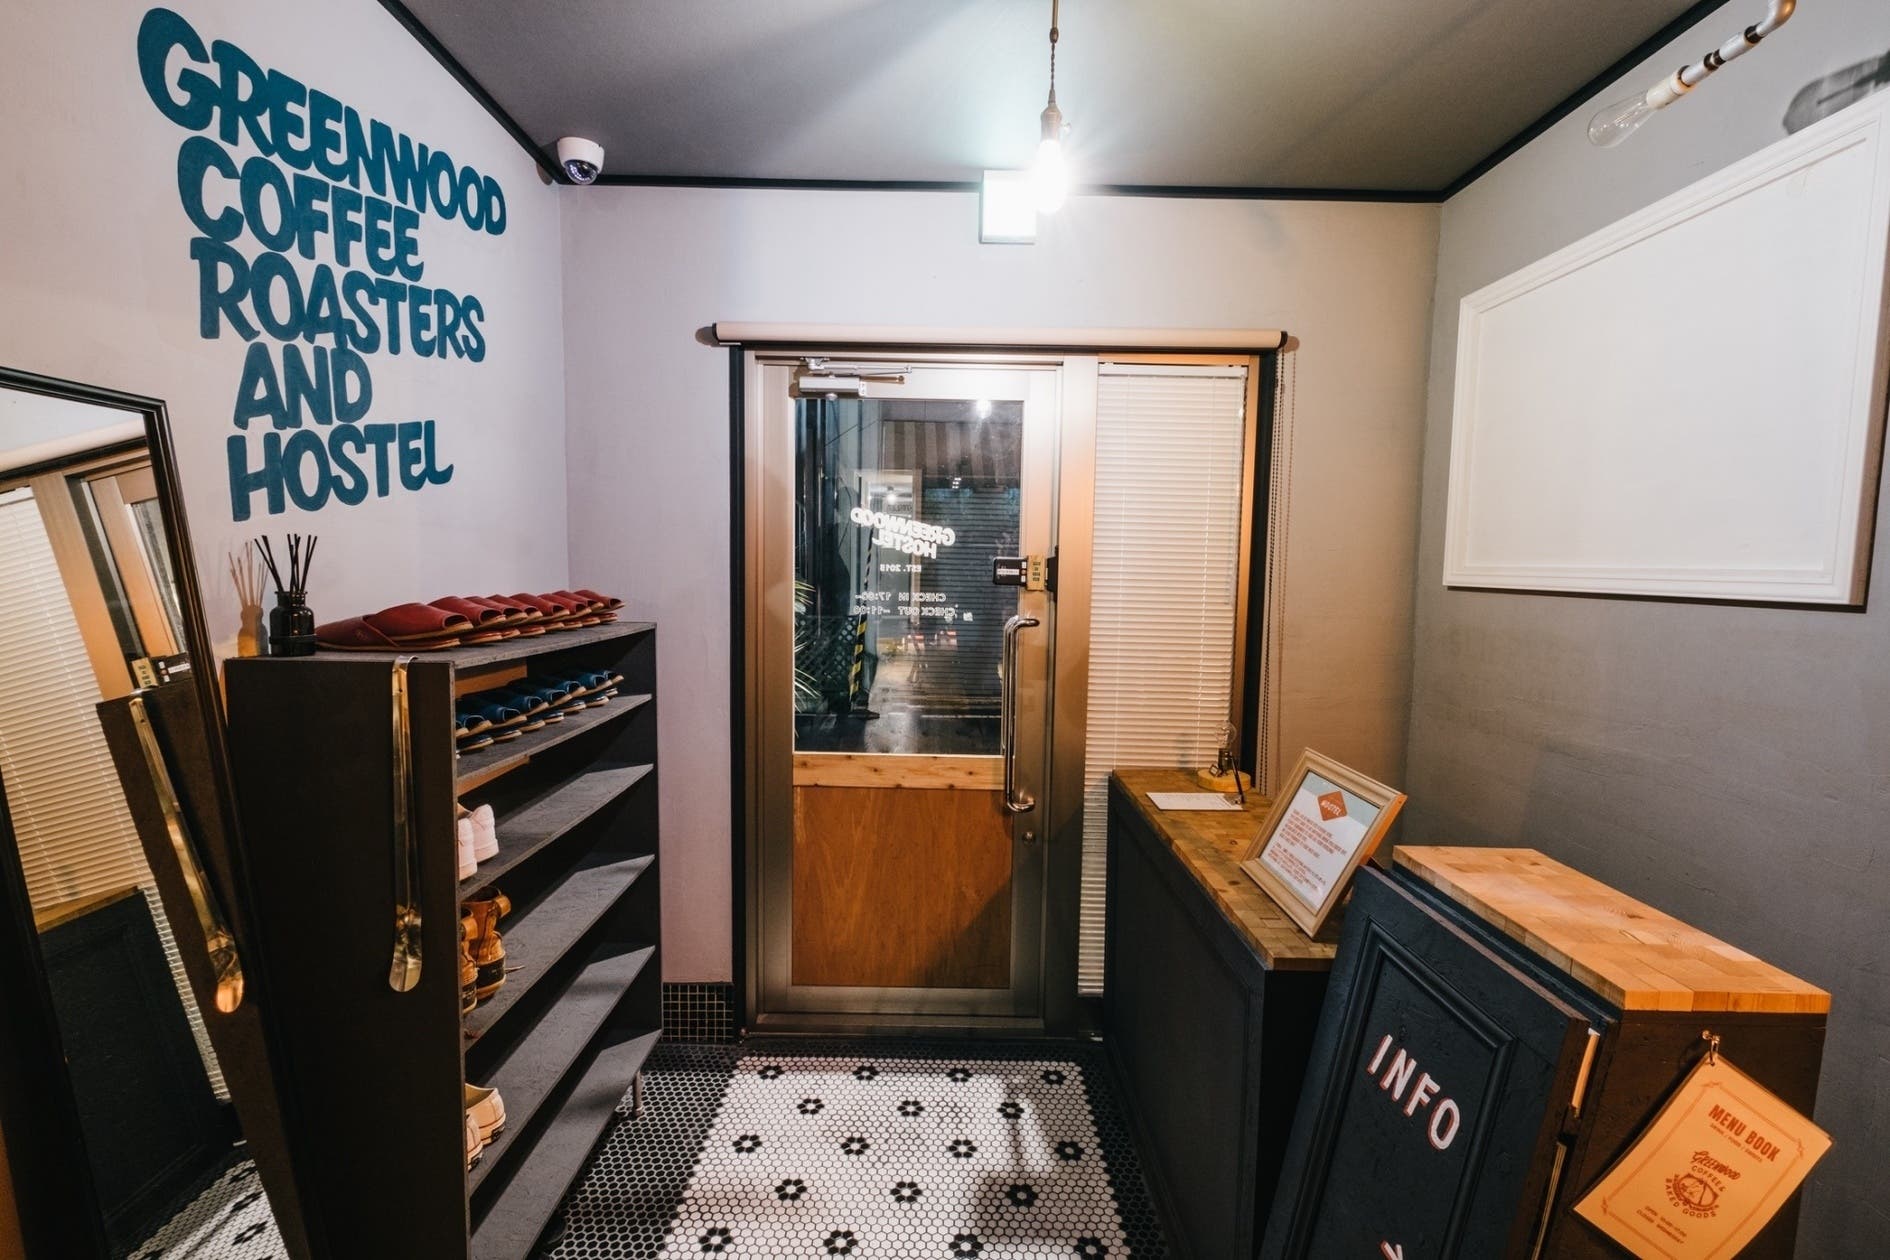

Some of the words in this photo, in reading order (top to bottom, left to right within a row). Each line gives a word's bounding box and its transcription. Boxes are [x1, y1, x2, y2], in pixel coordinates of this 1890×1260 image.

[137, 8, 507, 235] GREENWOOD
[177, 135, 425, 282] COFFEE
[190, 236, 486, 362] ROASTERS
[233, 342, 372, 431] AND
[227, 420, 454, 522] HOSTEL
[1366, 1034, 1460, 1150] INFO
[1708, 1104, 1747, 1137] MENU
[1744, 1130, 1781, 1162] BOOK
[1665, 1178, 1680, 1207] BAKED
[1682, 1208, 1717, 1219] GOODS
[1691, 1165, 1724, 1187] COFFEE
